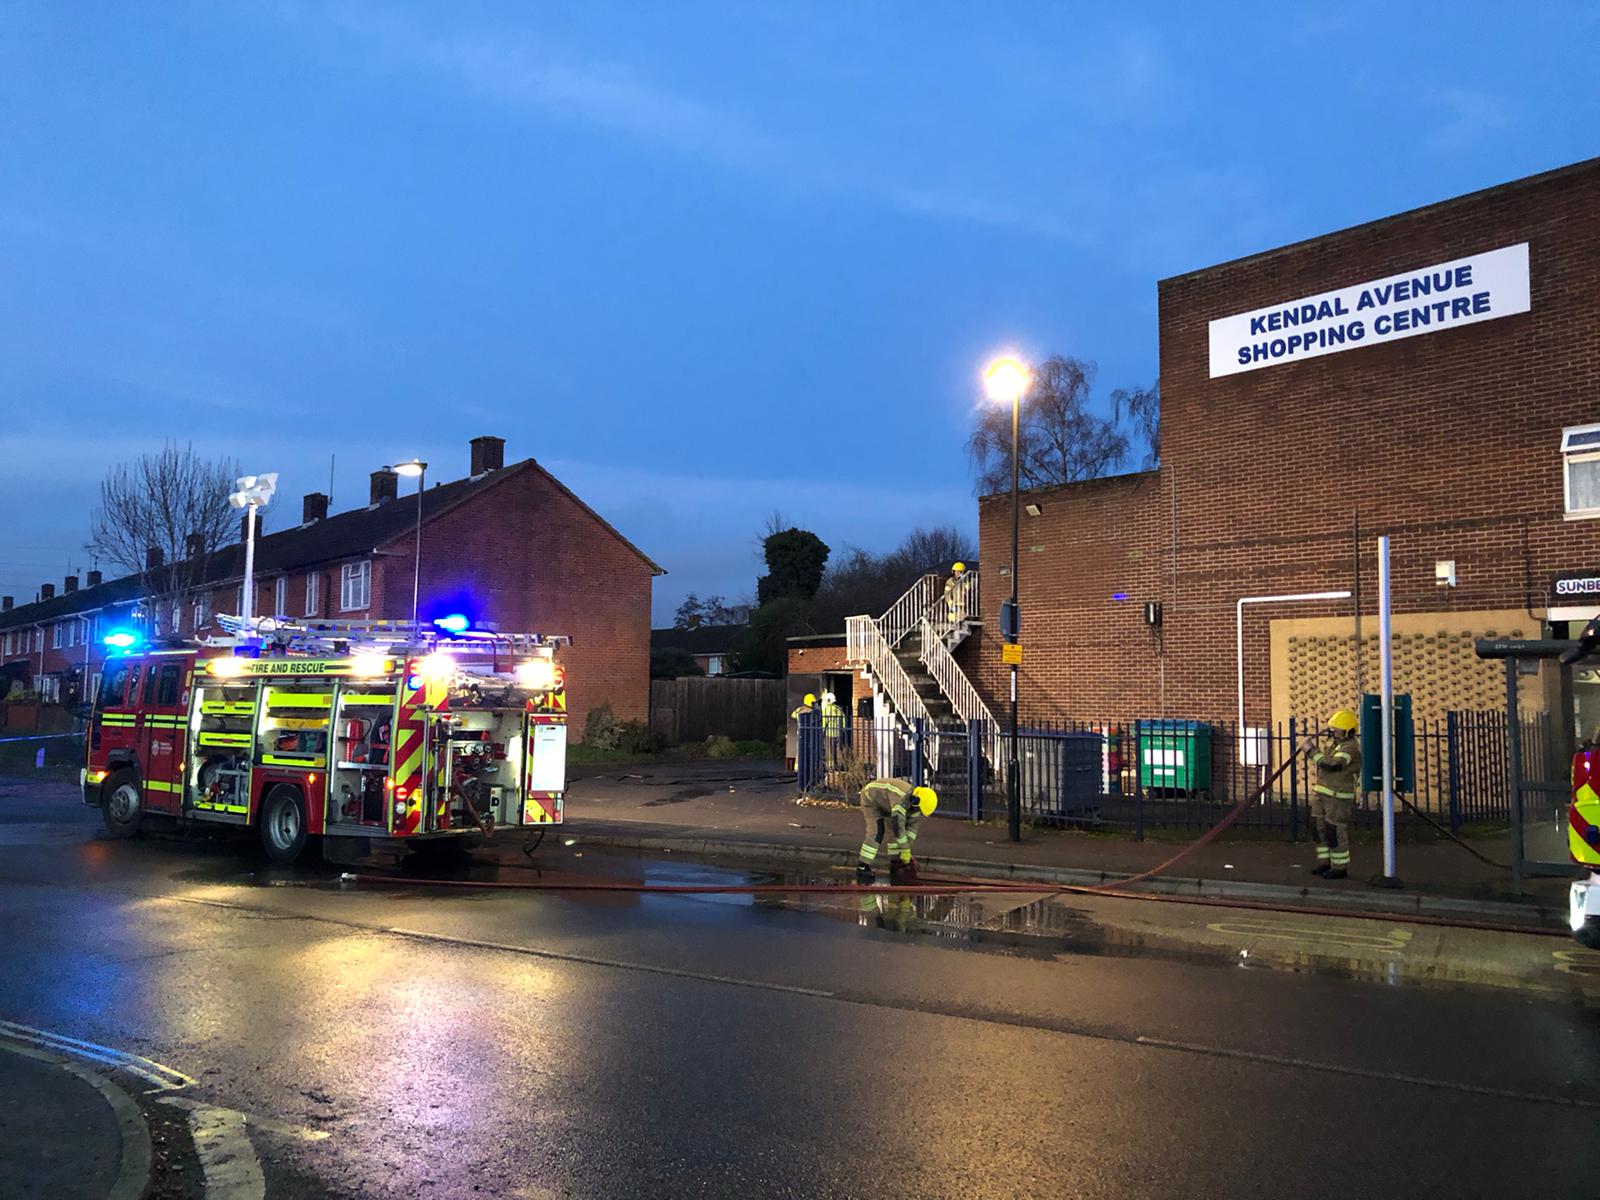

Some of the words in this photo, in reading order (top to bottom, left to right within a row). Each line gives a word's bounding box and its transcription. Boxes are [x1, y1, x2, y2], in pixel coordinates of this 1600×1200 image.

[1238, 321, 1364, 364] SHOPPING
[1374, 291, 1491, 335] CENTRE
[1251, 298, 1348, 335] KENDAL
[1357, 265, 1472, 311] AVENUE
[251, 663, 269, 673] FIRE
[271, 663, 288, 673] AND
[290, 662, 325, 673] RESCUE
